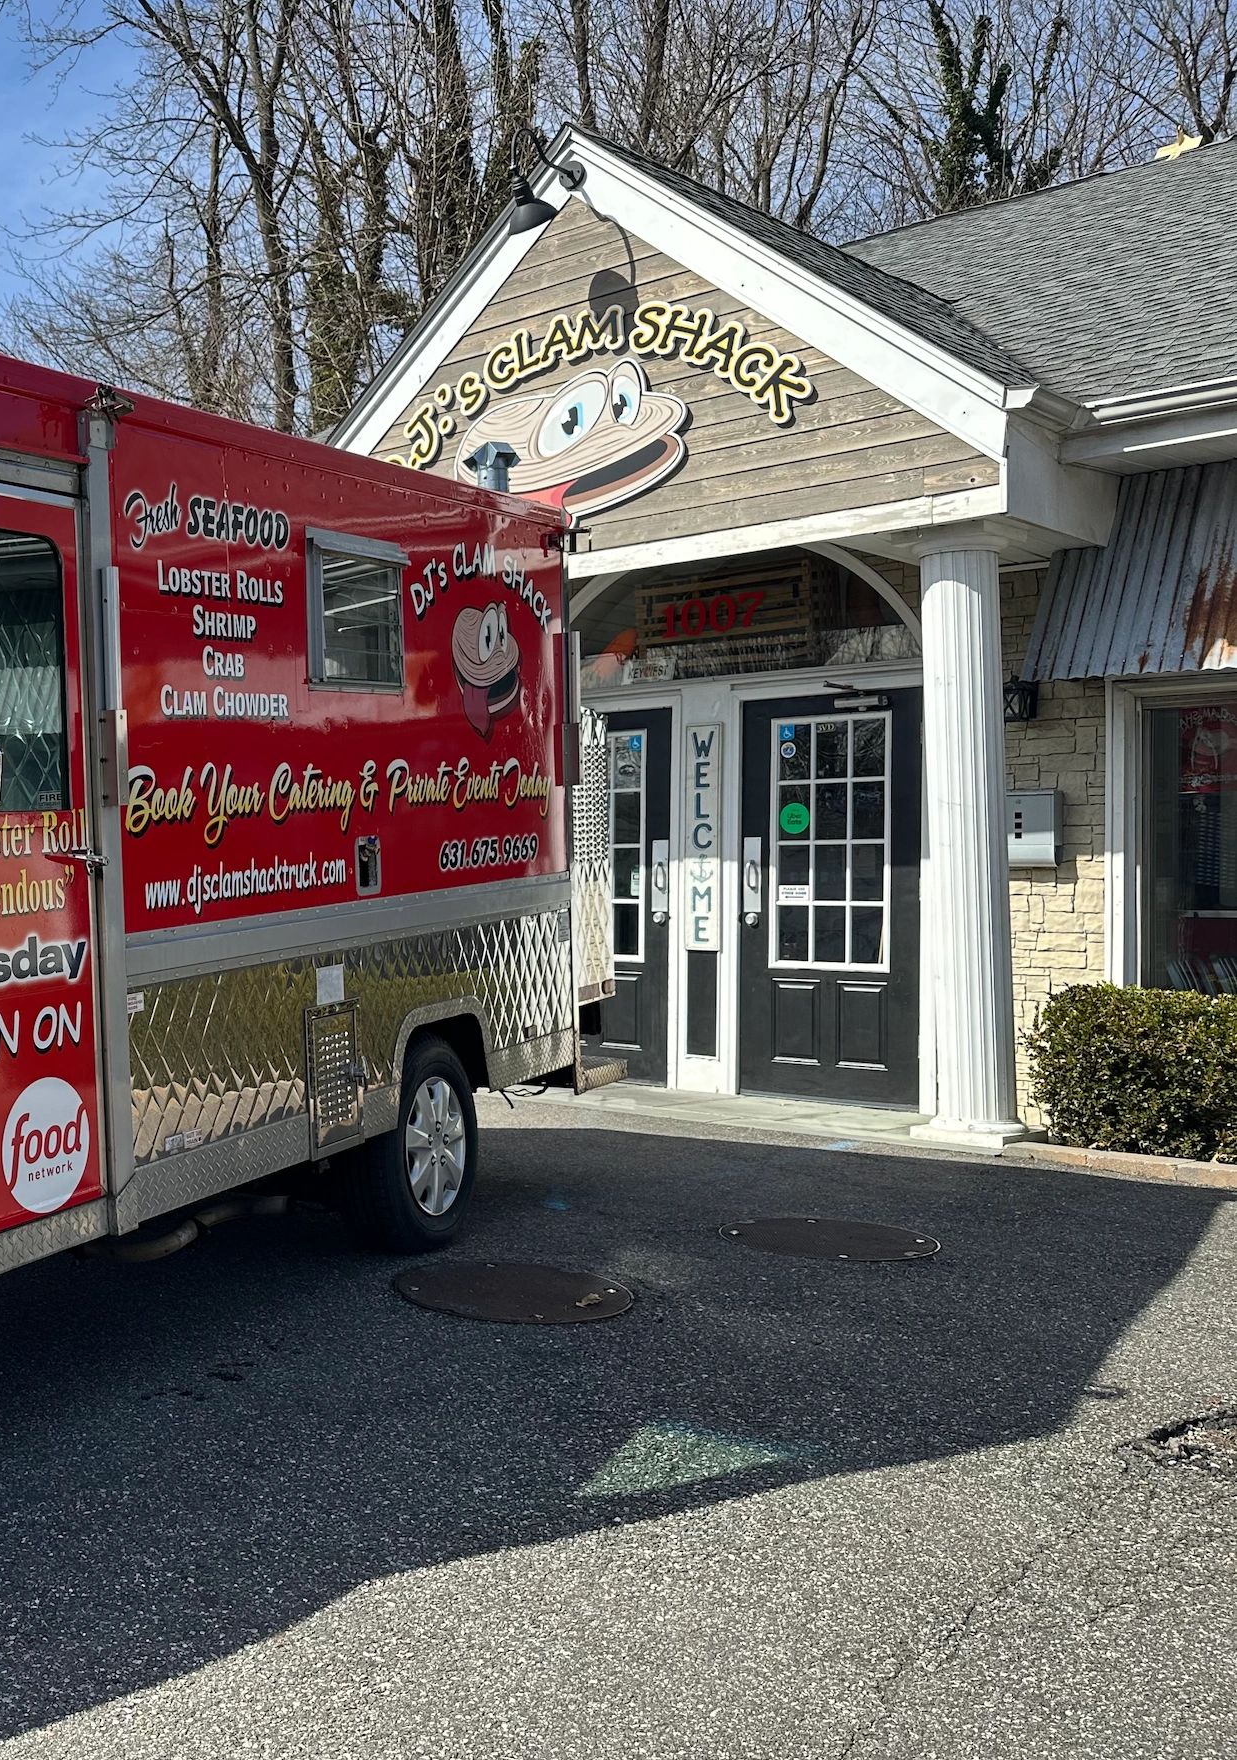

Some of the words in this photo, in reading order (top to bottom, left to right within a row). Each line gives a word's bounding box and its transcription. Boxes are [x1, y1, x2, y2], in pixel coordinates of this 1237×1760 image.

[483, 304, 625, 391] CLAM
[630, 300, 815, 425] SHACK
[125, 482, 183, 551] Fresh
[186, 496, 290, 551] SEAFOOD
[157, 559, 231, 599] LOBSTER
[236, 569, 285, 606] ROLLS
[452, 542, 497, 580] CLAM
[501, 555, 552, 635] SHACK
[193, 605, 257, 642] SHRIMP
[663, 591, 767, 639] 1007
[203, 645, 245, 680] CRAB
[160, 684, 207, 719] CLAM
[213, 686, 290, 721] CHOWDER
[125, 764, 196, 837] Book
[200, 761, 265, 848] Your
[269, 761, 355, 834] Catering
[359, 759, 380, 809] &
[386, 758, 451, 812] Private
[452, 757, 501, 811] Events
[502, 757, 552, 816] Today
[41, 808, 89, 854] Roll
[439, 834, 539, 872] 631.675.9669
[144, 852, 347, 914] www.djsclamshacktruck.com
[32, 1001, 82, 1051] ON
[9, 1103, 85, 1191] food
[27, 1160, 73, 1182] network
